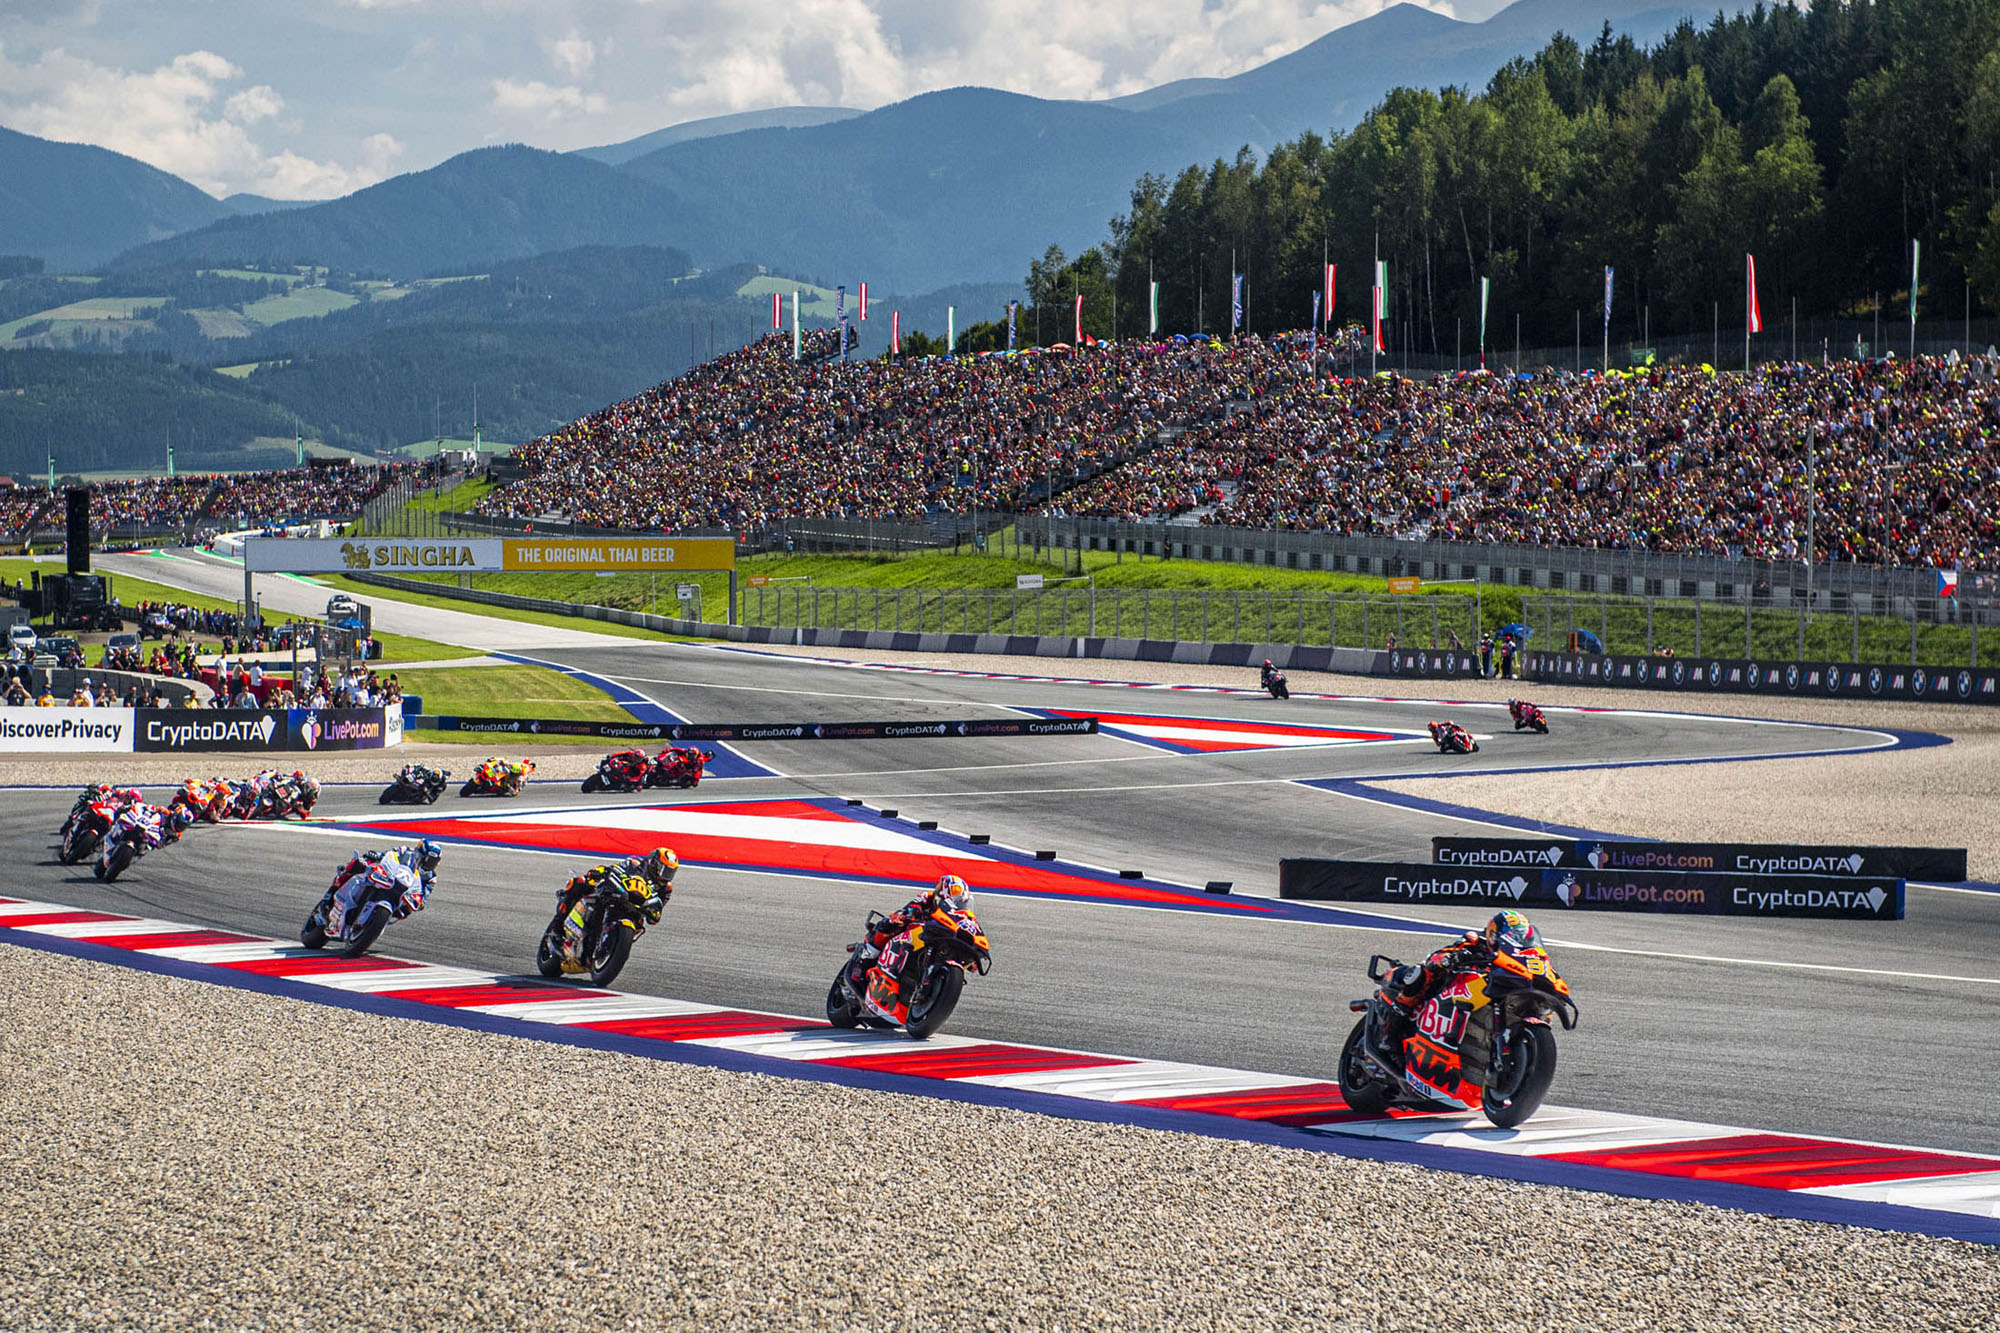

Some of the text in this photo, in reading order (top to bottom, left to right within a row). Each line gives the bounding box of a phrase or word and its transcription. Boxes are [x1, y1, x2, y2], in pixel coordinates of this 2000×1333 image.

[375, 546, 475, 566] SINGHA
[517, 548, 674, 562] THE ORIGINAL THAI BEER
[148, 721, 263, 746] CryptoDATA
[324, 720, 379, 740] LivePot.com
[600, 726, 654, 736] CryptoDATA
[743, 727, 797, 738] CryptoDATA
[885, 725, 940, 736] CryptoDATA
[1029, 723, 1084, 733] CryptoDATA
[1439, 849, 1851, 873] CryptoDATA LivePot.com CryptoDATA
[1384, 876, 1870, 911] CryptoDATA LivePot.com CryptoDATA
[1406, 1040, 1461, 1095] KTM
